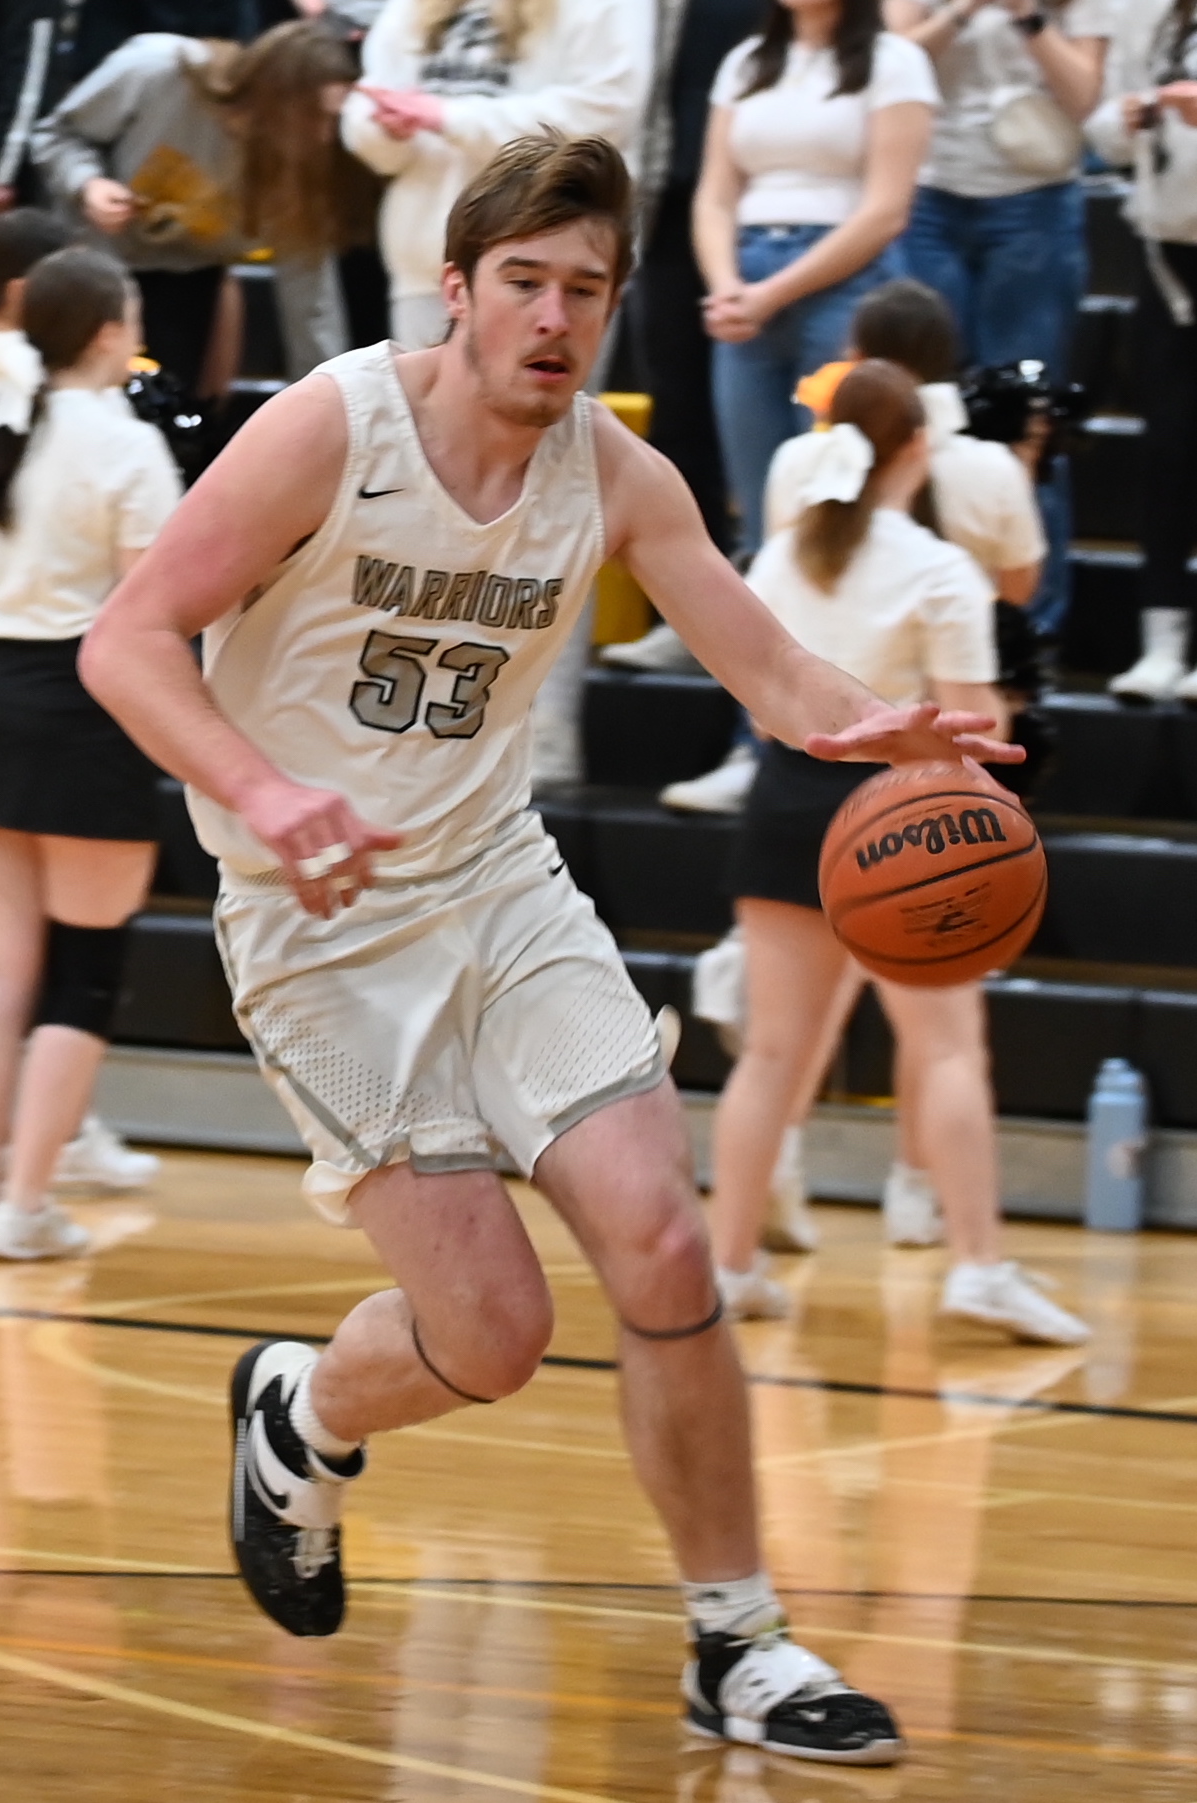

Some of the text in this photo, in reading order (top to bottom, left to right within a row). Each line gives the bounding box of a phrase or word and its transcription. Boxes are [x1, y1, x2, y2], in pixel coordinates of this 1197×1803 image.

[351, 554, 564, 629] WARRIORS
[349, 630, 510, 739] 53
[856, 808, 1007, 872] Wilson
